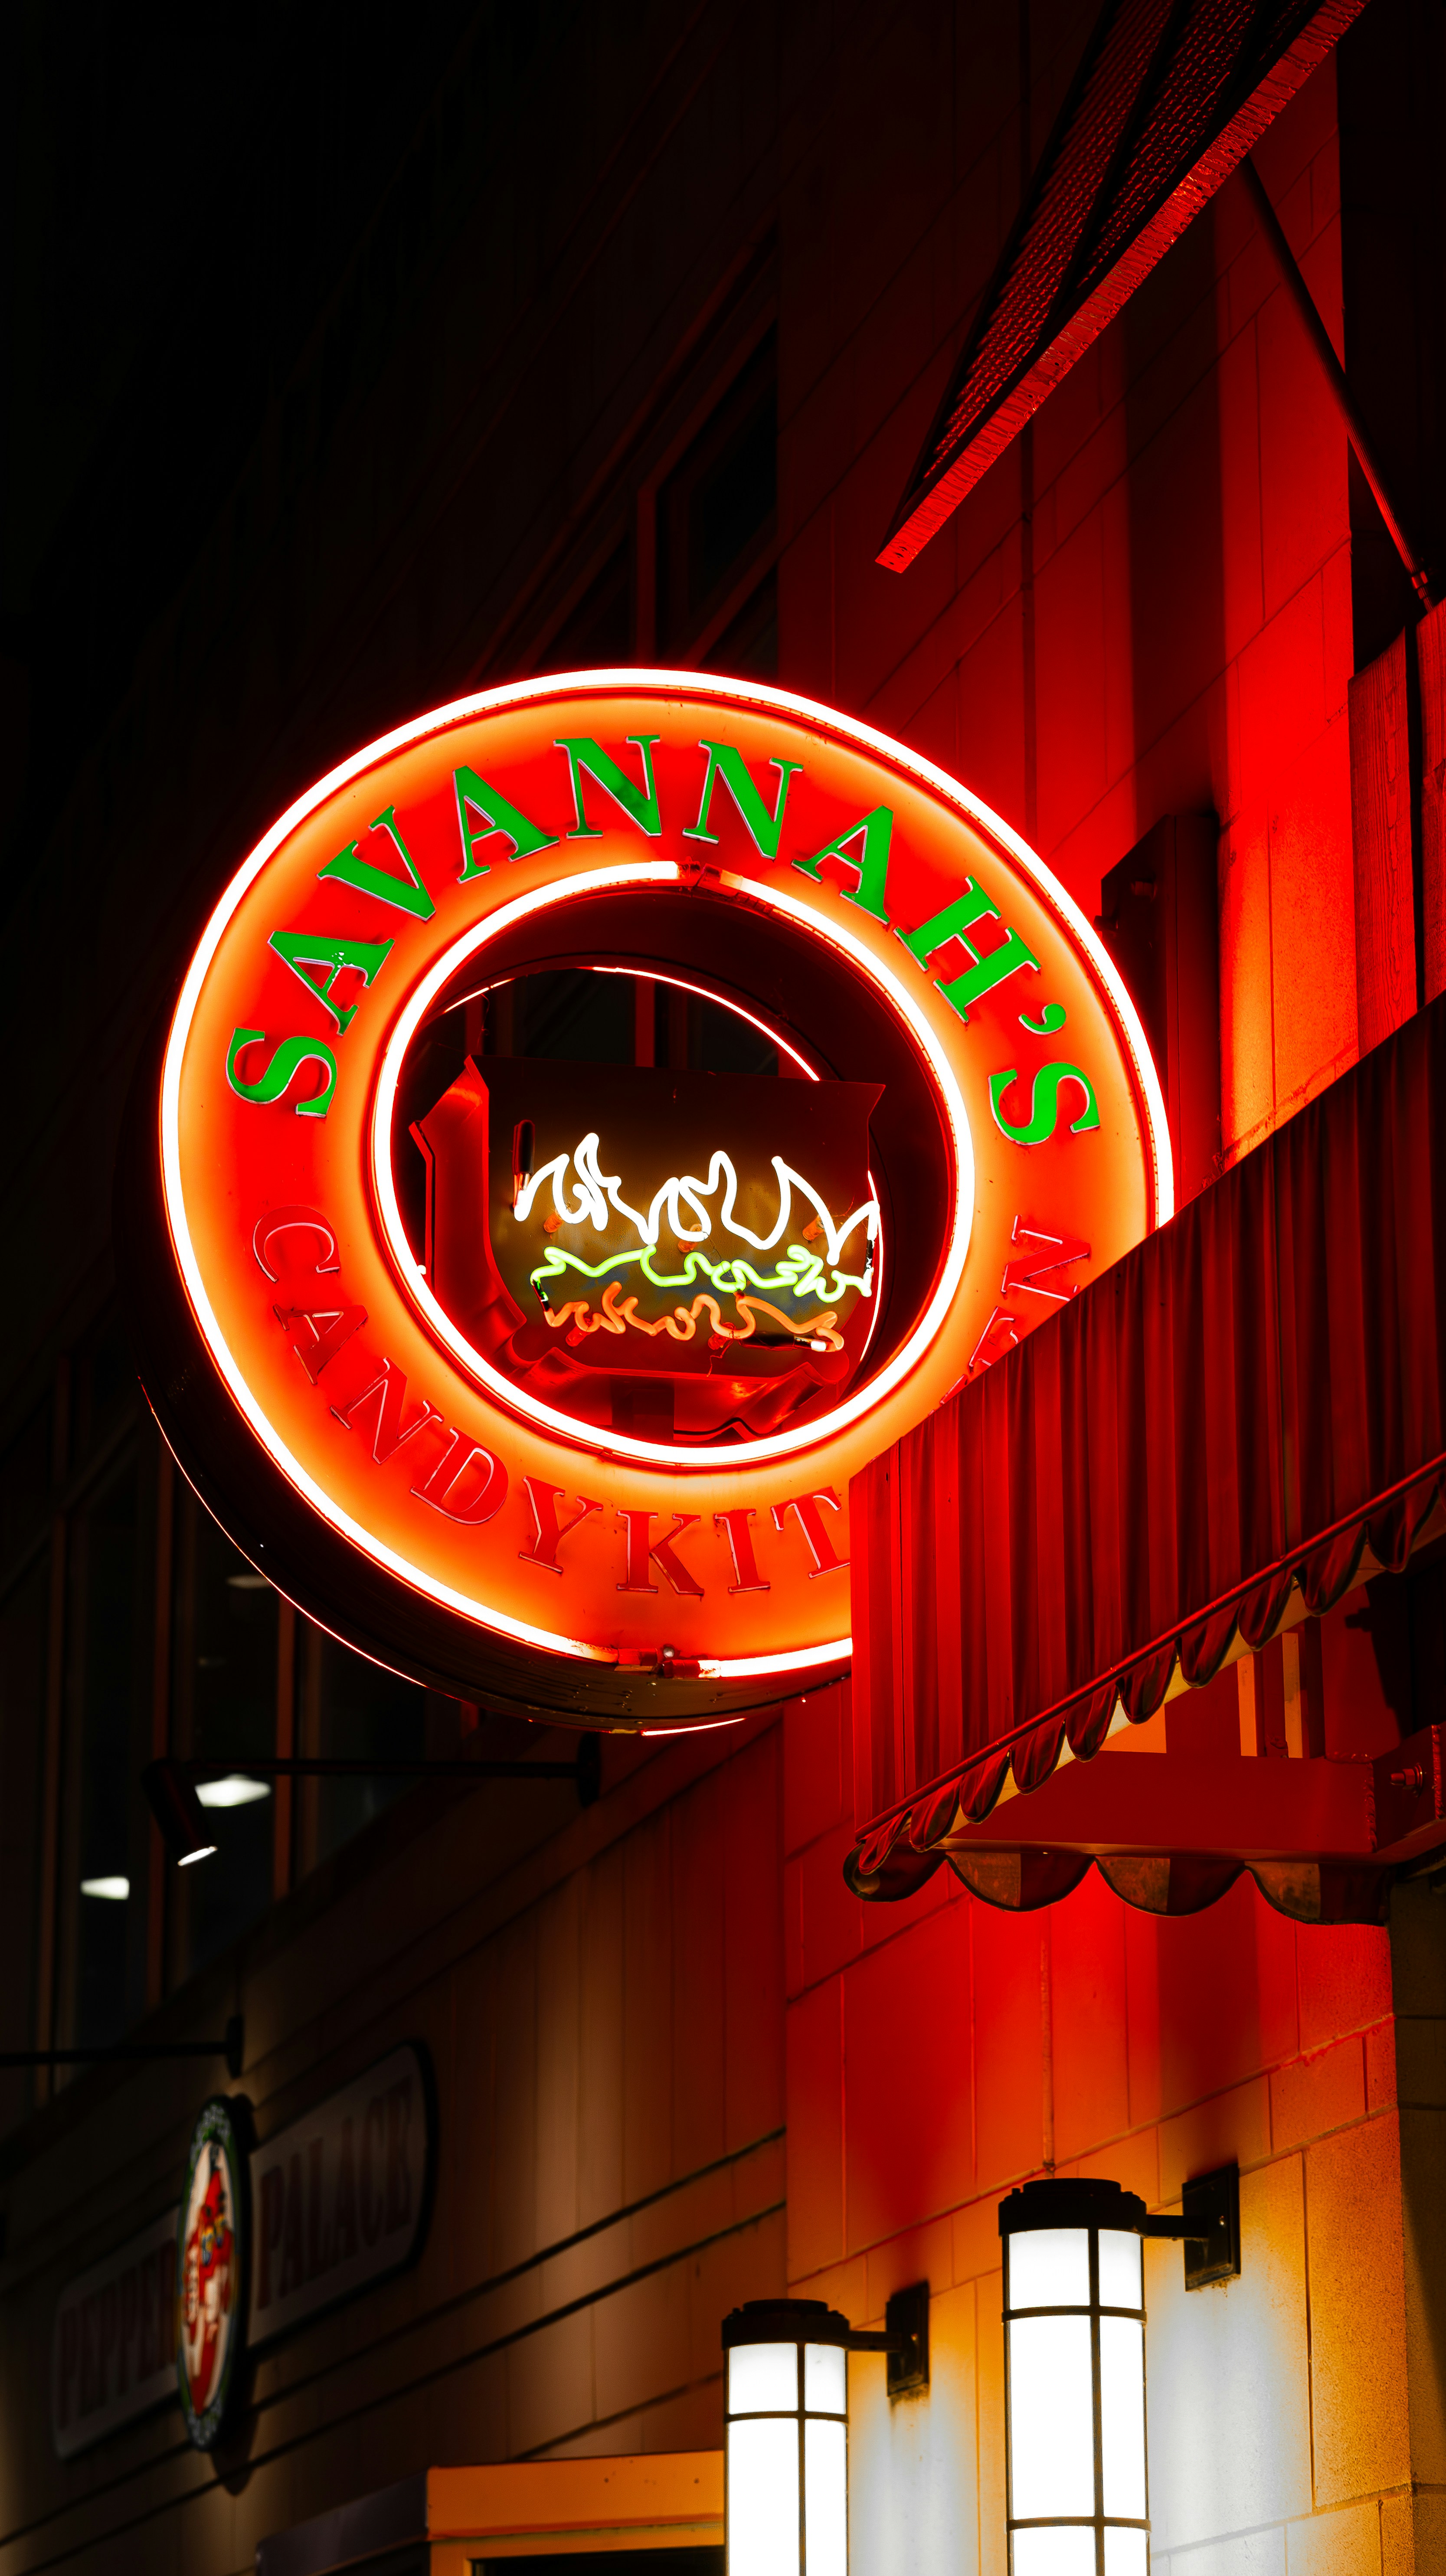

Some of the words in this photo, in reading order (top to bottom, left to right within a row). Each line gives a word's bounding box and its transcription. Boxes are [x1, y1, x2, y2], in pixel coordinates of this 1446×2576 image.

[227, 735, 1101, 1146] SAVANNAH'S
[616, 1214, 1091, 1597] KITN
[257, 2075, 413, 2310] PALACE
